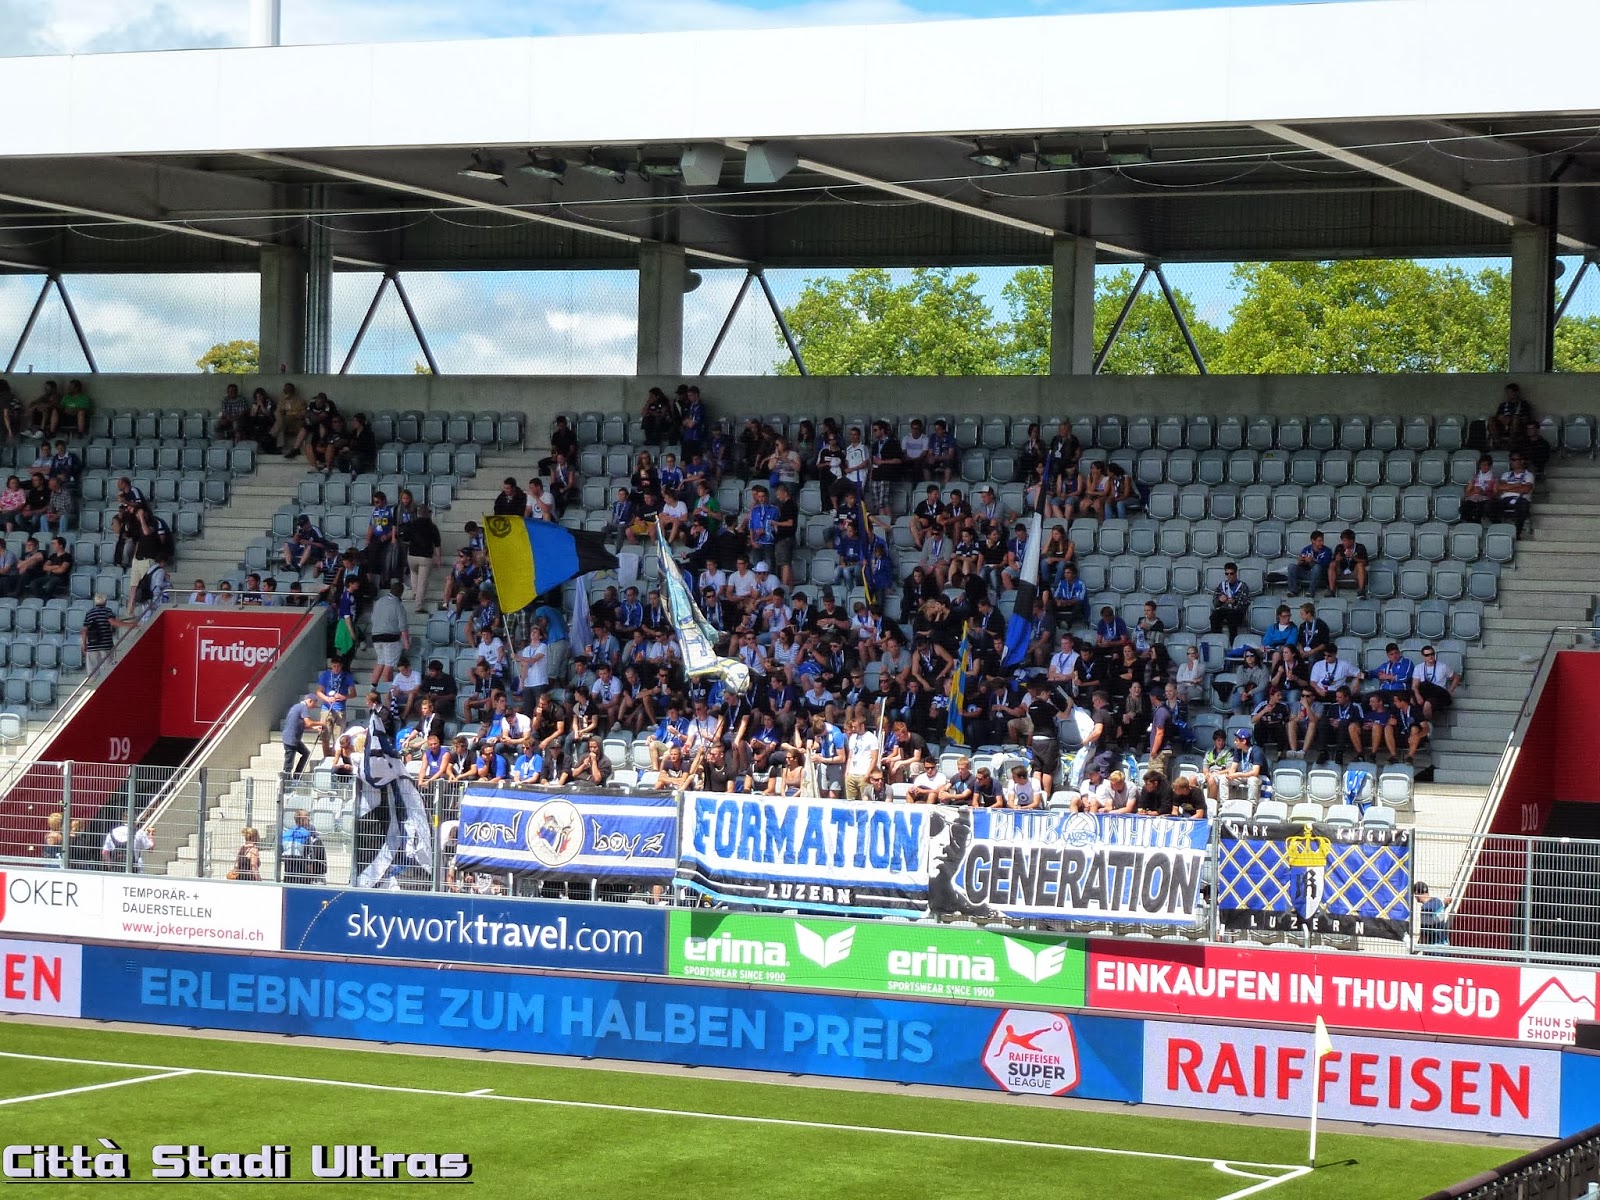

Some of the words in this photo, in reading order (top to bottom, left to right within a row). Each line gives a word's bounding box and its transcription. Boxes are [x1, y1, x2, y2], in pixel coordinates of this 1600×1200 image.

[201, 639, 276, 667] Frutiger
[109, 736, 131, 761] D9
[1520, 803, 1539, 831] D10
[693, 797, 923, 872] FORMATION
[1233, 824, 1269, 837] DARK
[1336, 826, 1409, 843] KNIGHTS
[965, 845, 1201, 915] GENERATION
[767, 883, 852, 904] LUZERN
[122, 902, 213, 918] DAUERSTELLEN
[122, 921, 264, 942] www.jokerpersonal.ch
[347, 904, 644, 955] skyworktravel.com
[1250, 914, 1365, 935] LUZERN
[684, 932, 787, 967] erima
[683, 965, 738, 979] SPORTSWEAR
[740, 970, 764, 981] SINCE
[766, 971, 786, 982] 1900
[888, 945, 996, 981] erima
[887, 980, 944, 994] SPORTSWEAR
[946, 985, 971, 996] SINCE
[973, 986, 995, 998] 1900
[1097, 961, 1280, 1001] EINKAUFEN
[1290, 972, 1323, 1005] IN
[1332, 976, 1423, 1012] THUN
[1432, 977, 1501, 1019] SÜD
[140, 966, 425, 1025] ERLEBNISSE
[438, 987, 544, 1033] ZUM
[561, 995, 766, 1049] HALBEN
[784, 1010, 933, 1063] PREIS
[1527, 1016, 1560, 1028] THUN
[1008, 1052, 1060, 1065] RAIFFEISEN
[1008, 1062, 1065, 1080] SUPER
[1167, 1038, 1531, 1119] RAIFFEISEN
[1008, 1077, 1051, 1089] LEAGUE
